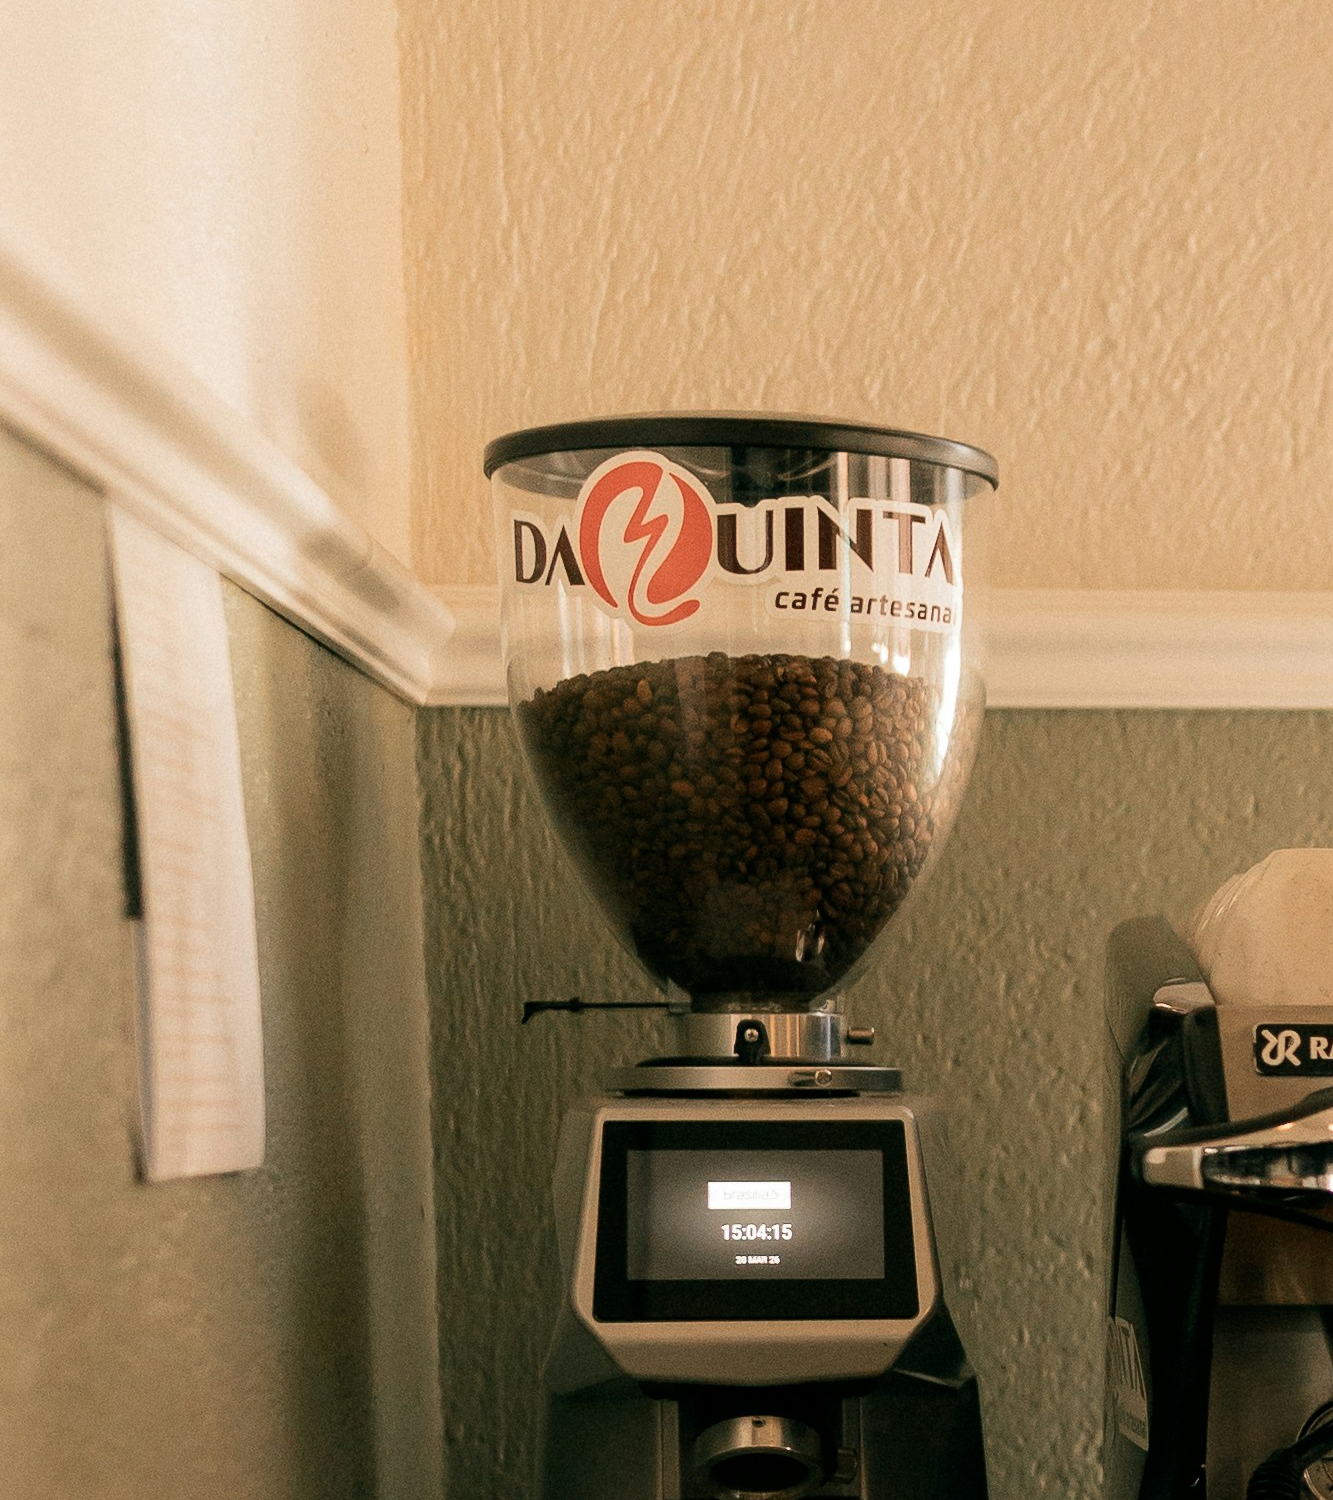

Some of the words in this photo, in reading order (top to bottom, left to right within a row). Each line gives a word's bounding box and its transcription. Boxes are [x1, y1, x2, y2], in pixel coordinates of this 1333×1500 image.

[774, 587, 838, 612] café
[721, 1223, 793, 1241] 15:04:15
[748, 1255, 768, 1264] MAR
